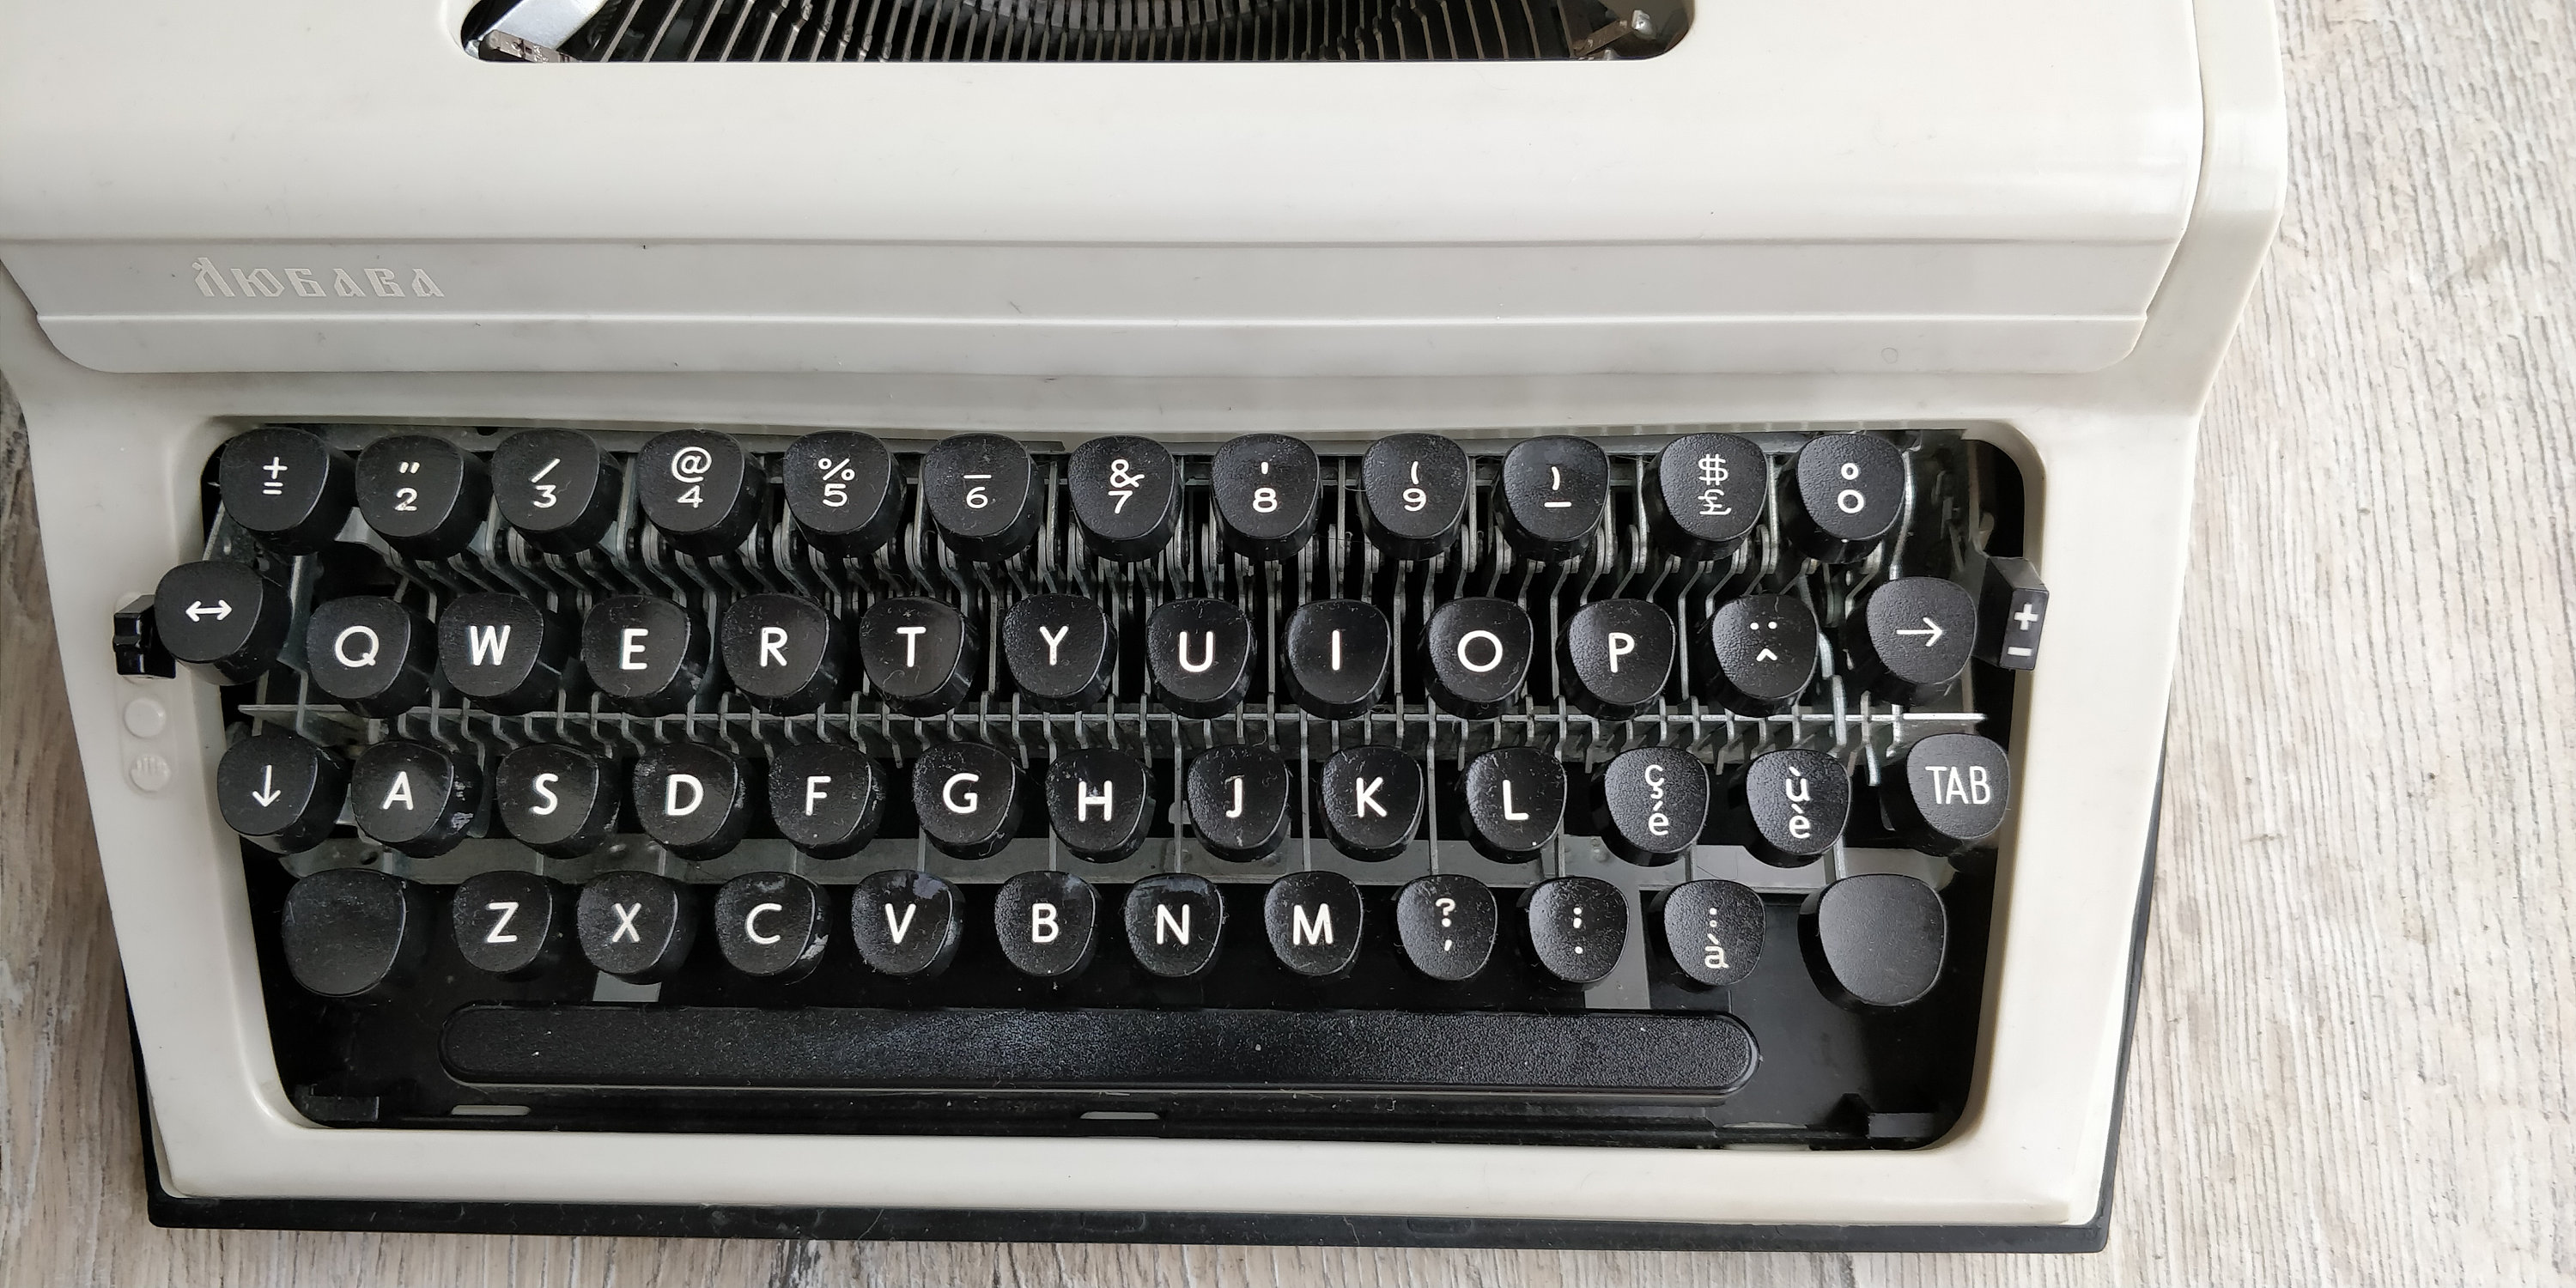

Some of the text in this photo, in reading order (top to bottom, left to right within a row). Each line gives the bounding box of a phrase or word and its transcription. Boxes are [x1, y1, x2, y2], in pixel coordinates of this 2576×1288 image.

[671, 446, 713, 483] @
[817, 458, 855, 481] %
[1109, 459, 1145, 489] &
[1697, 453, 1729, 486] $
[394, 487, 418, 512] 2
[532, 484, 557, 508] 3
[677, 484, 704, 508] 4
[822, 483, 848, 507] 5
[966, 486, 988, 509] 6
[1108, 489, 1133, 514] 7
[1252, 487, 1278, 513] 8
[1402, 488, 1427, 512] 9
[1697, 489, 1732, 516] £
[334, 625, 380, 668] Q
[469, 624, 511, 666] W
[620, 628, 649, 671] E
[760, 626, 788, 667] R
[896, 626, 927, 668] T
[1039, 625, 1069, 666] Y
[1178, 630, 1214, 673] U
[1331, 629, 1341, 671] I
[1457, 629, 1504, 673] O
[1607, 632, 1636, 673] P
[382, 770, 414, 811] A
[531, 773, 559, 816] S
[665, 774, 704, 817] D
[805, 775, 832, 817] F
[942, 772, 980, 814] G
[1078, 780, 1113, 822] H
[1225, 777, 1243, 818] J
[1353, 776, 1388, 818] K
[1502, 779, 1529, 821] L
[1643, 763, 1666, 800] ç
[1784, 766, 1811, 802] ù
[1925, 765, 1991, 805] TAB
[1647, 801, 1669, 836] é
[1789, 803, 1811, 839] è
[485, 902, 519, 944] Z
[610, 902, 641, 943] X
[744, 902, 782, 945] C
[884, 902, 917, 945] V
[1031, 902, 1060, 943] B
[1156, 903, 1190, 945] N
[1292, 902, 1334, 945] M
[1435, 897, 1456, 928] ?
[1704, 933, 1730, 969] à
